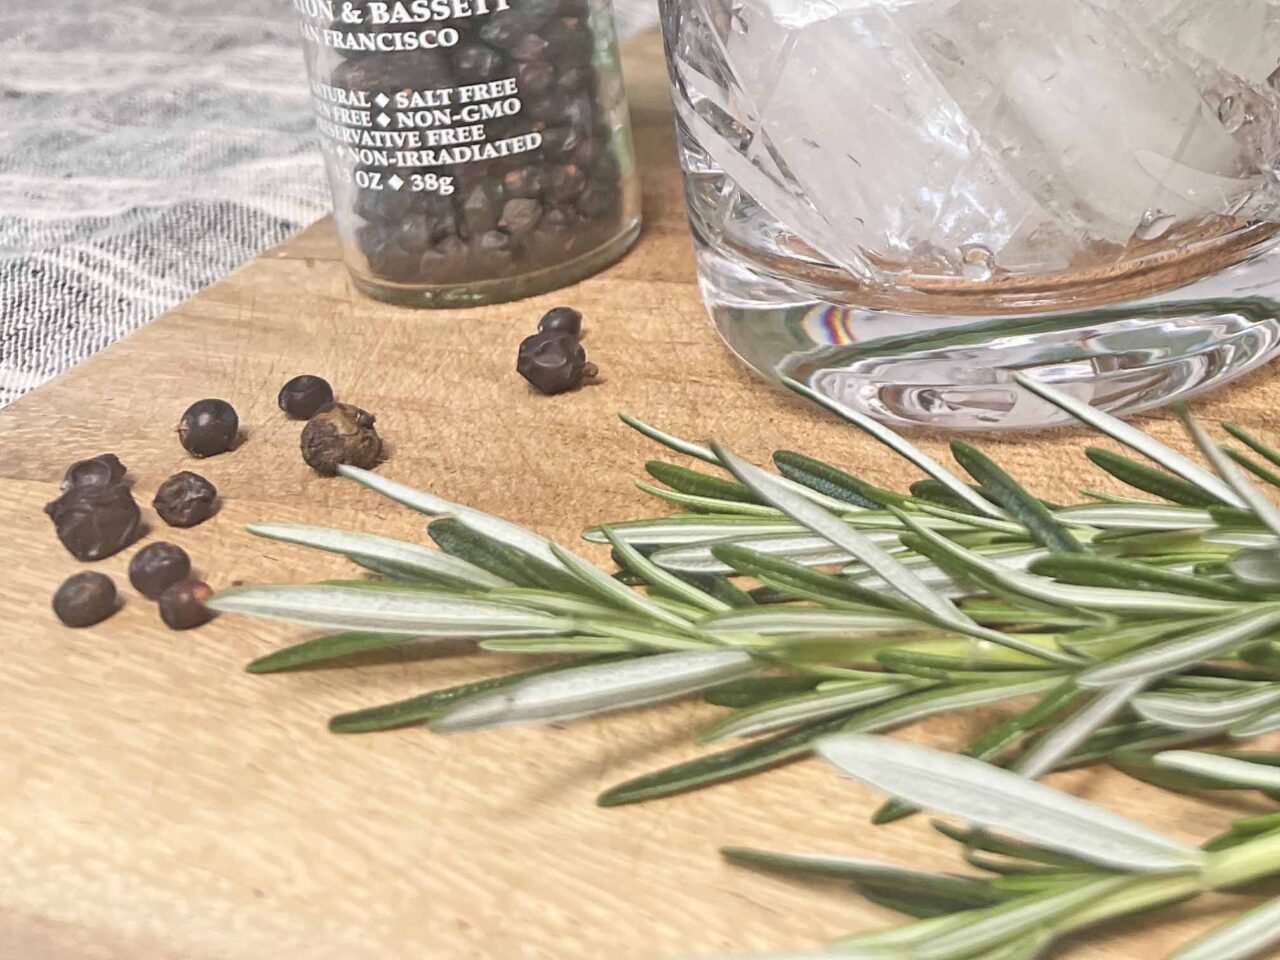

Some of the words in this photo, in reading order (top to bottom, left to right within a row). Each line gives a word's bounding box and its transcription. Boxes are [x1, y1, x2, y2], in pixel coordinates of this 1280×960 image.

[341, 1, 364, 24] &
[323, 28, 460, 52] FRANCISCO
[395, 89, 453, 109] SALT
[458, 77, 519, 97] FREE
[332, 106, 373, 127] FREE
[397, 97, 522, 128] NON-GMO
[425, 124, 487, 145] FREE
[347, 132, 543, 168] NON-IRRADIATED
[355, 170, 384, 189] OZ
[410, 173, 455, 196] 38g
